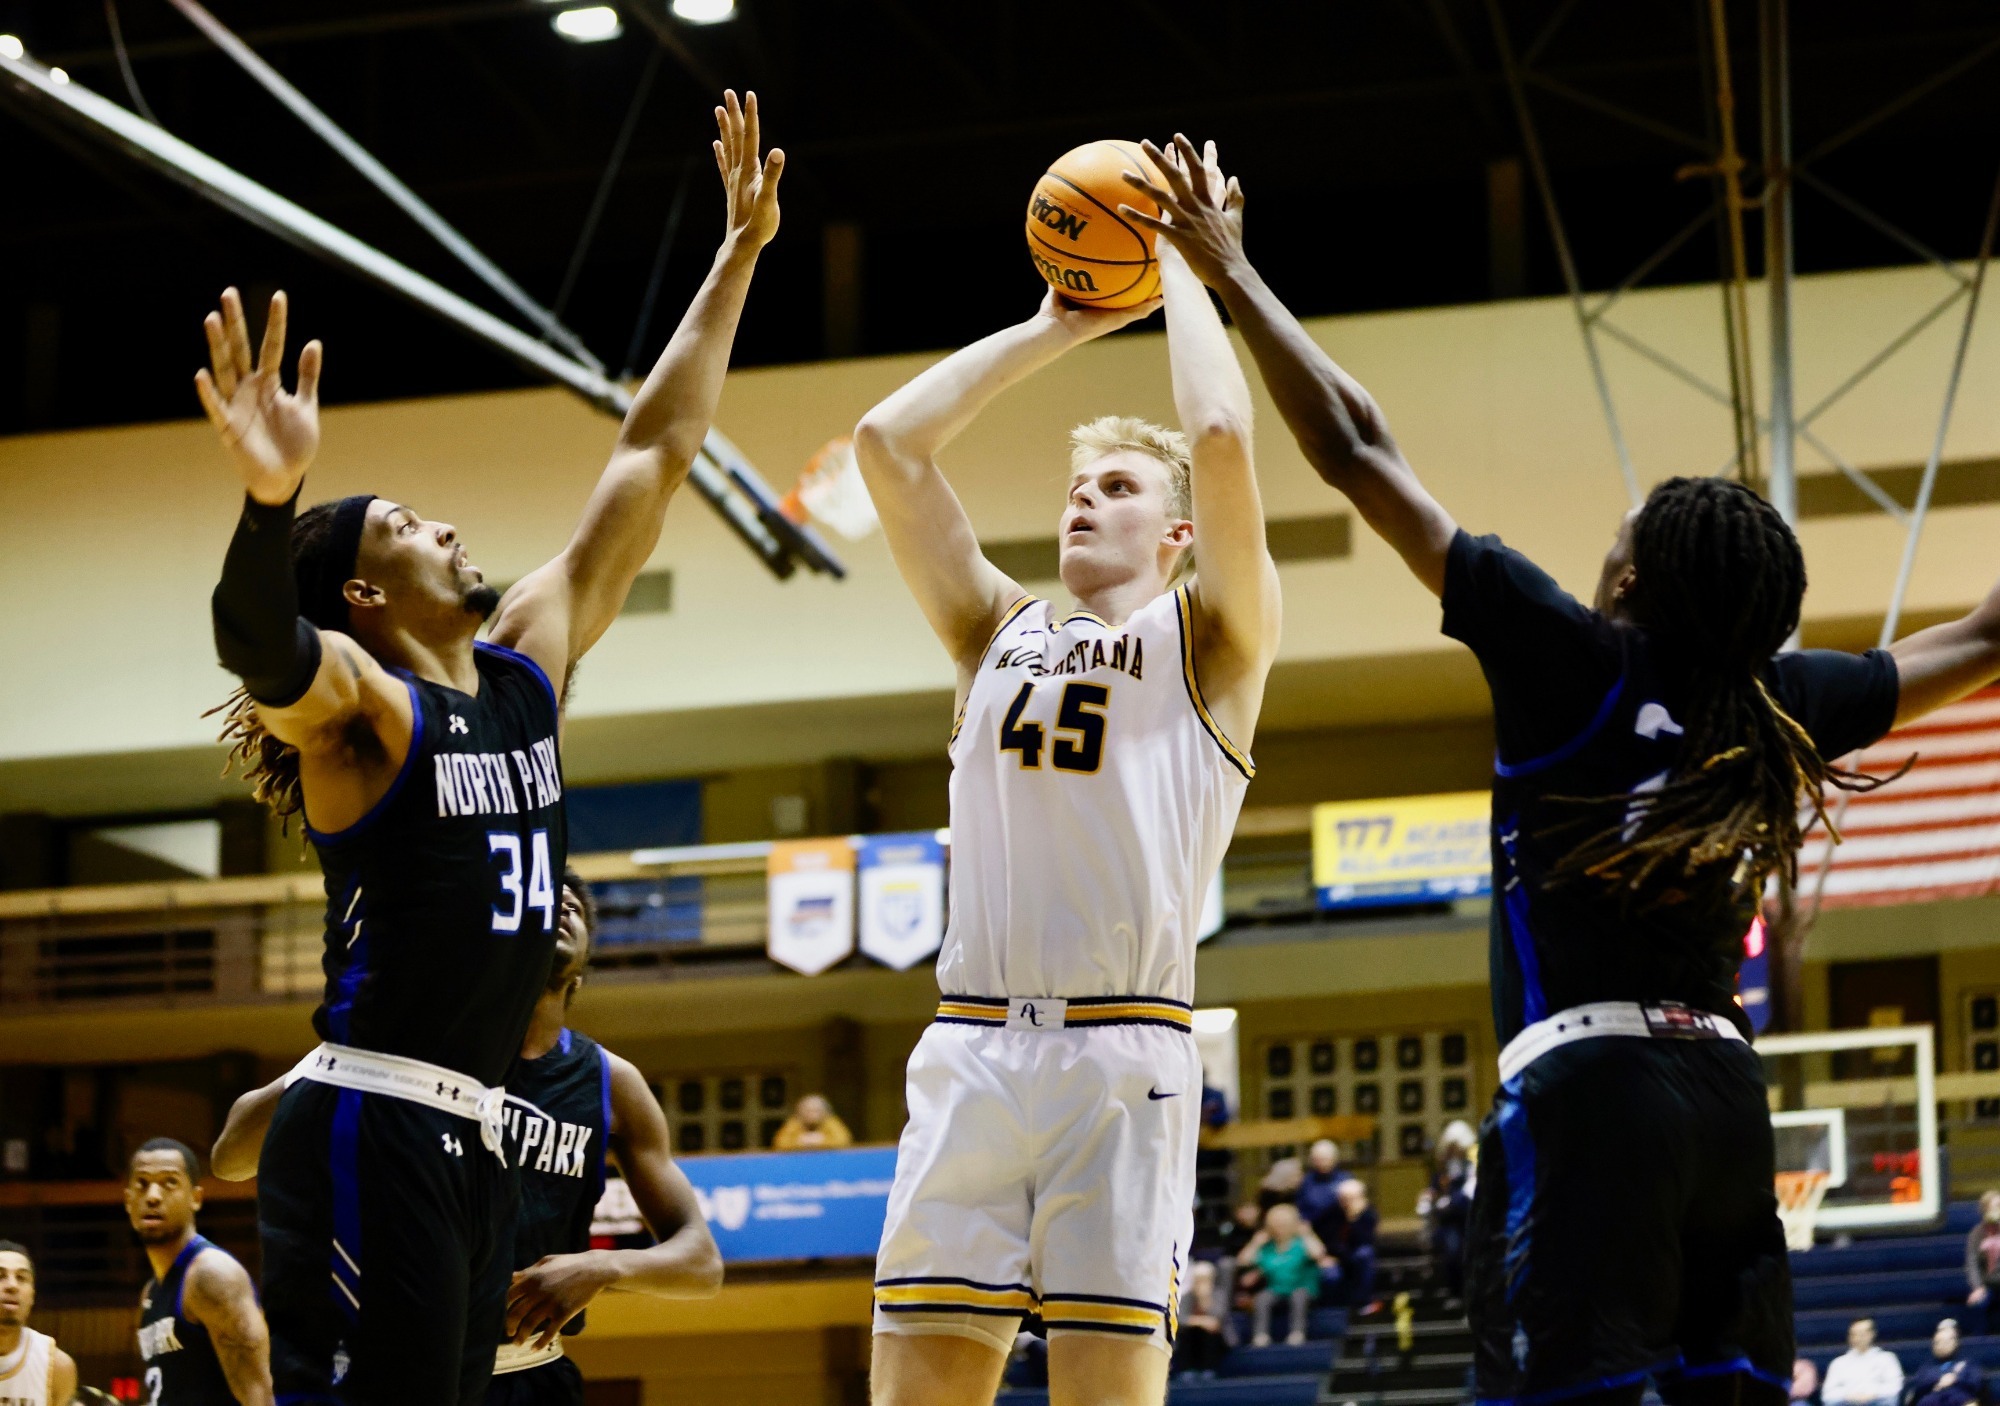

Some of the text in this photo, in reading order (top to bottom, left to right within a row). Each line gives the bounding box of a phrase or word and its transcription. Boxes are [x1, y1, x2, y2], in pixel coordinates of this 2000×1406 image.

[1031, 194, 1088, 241] NCAA
[999, 679, 1112, 776] 45
[433, 735, 562, 817] NORTH PARK
[486, 827, 555, 936] 34
[518, 1115, 593, 1178] PARK
